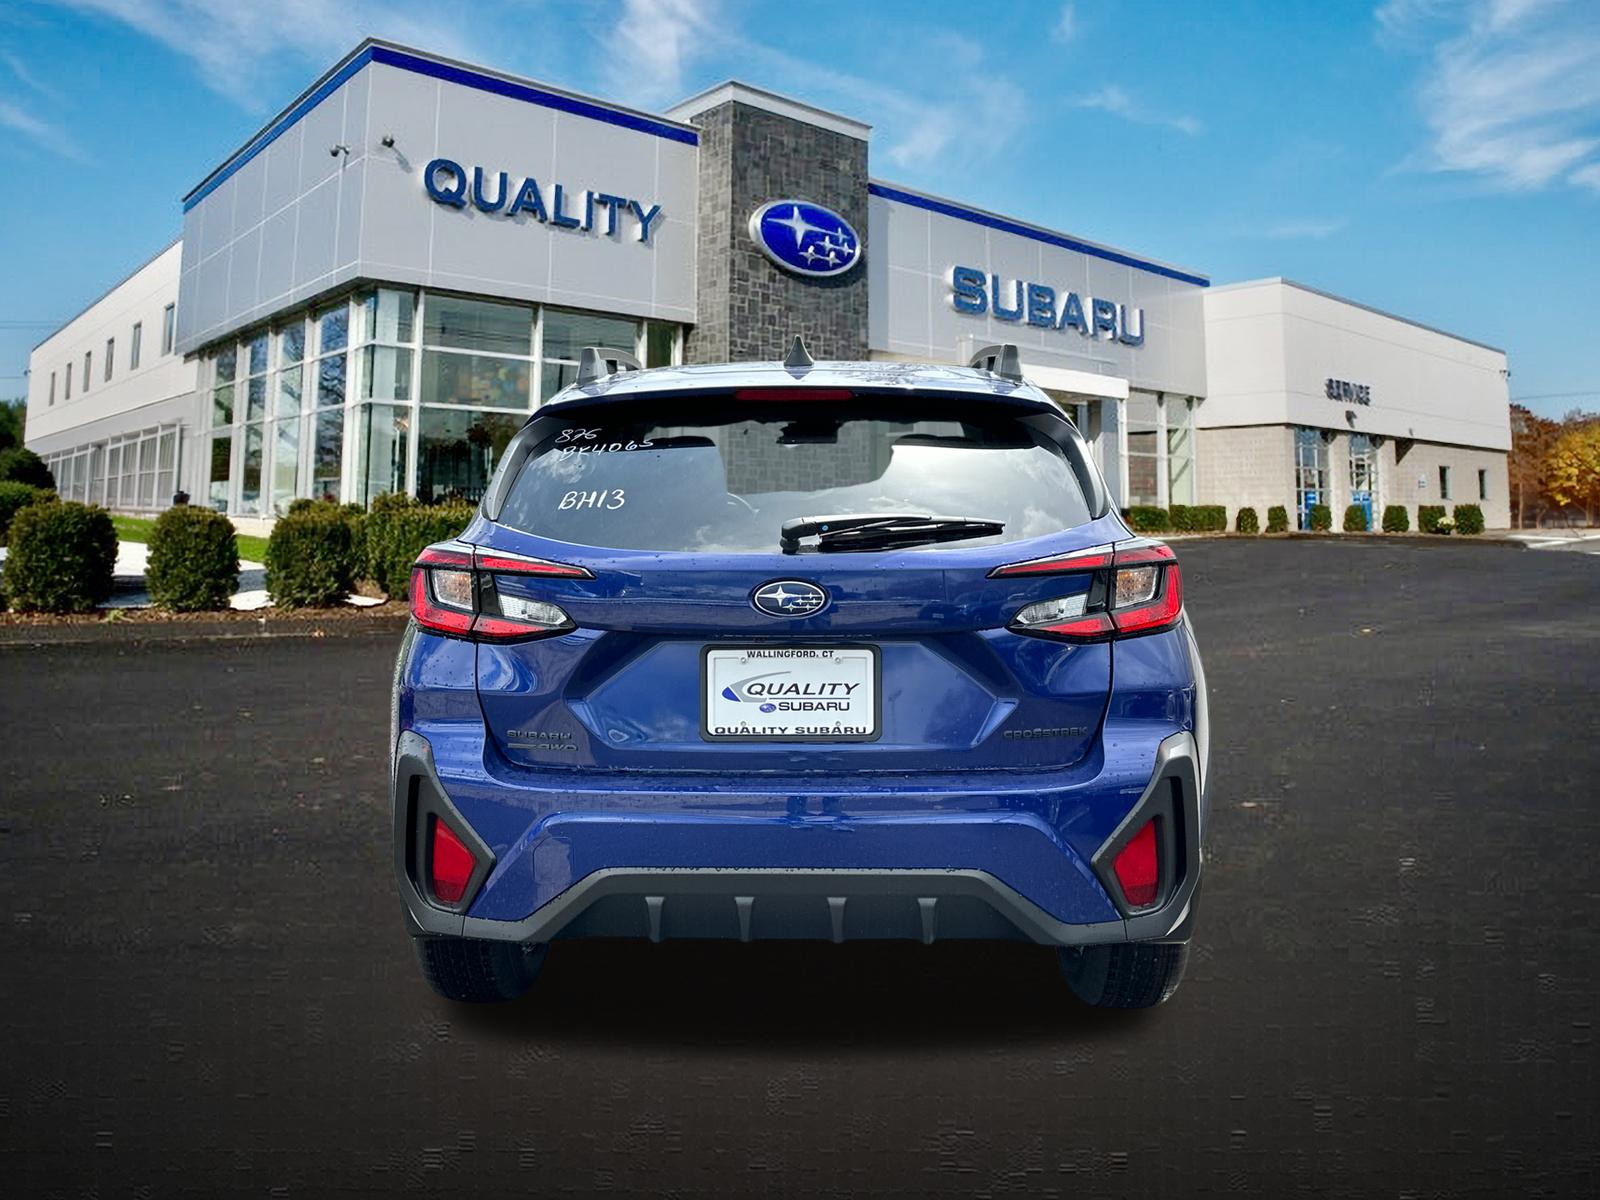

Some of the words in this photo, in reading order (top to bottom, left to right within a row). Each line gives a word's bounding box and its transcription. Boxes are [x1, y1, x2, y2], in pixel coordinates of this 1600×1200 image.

[423, 157, 662, 243] QUALITY
[952, 265, 1145, 346] SUBARU
[558, 489, 625, 510] BH13
[822, 650, 834, 658] CT
[747, 683, 860, 696] QUALITY
[778, 702, 850, 711] SUBARU
[506, 729, 572, 740] SUBARU
[1003, 726, 1088, 739] CROSSTREK
